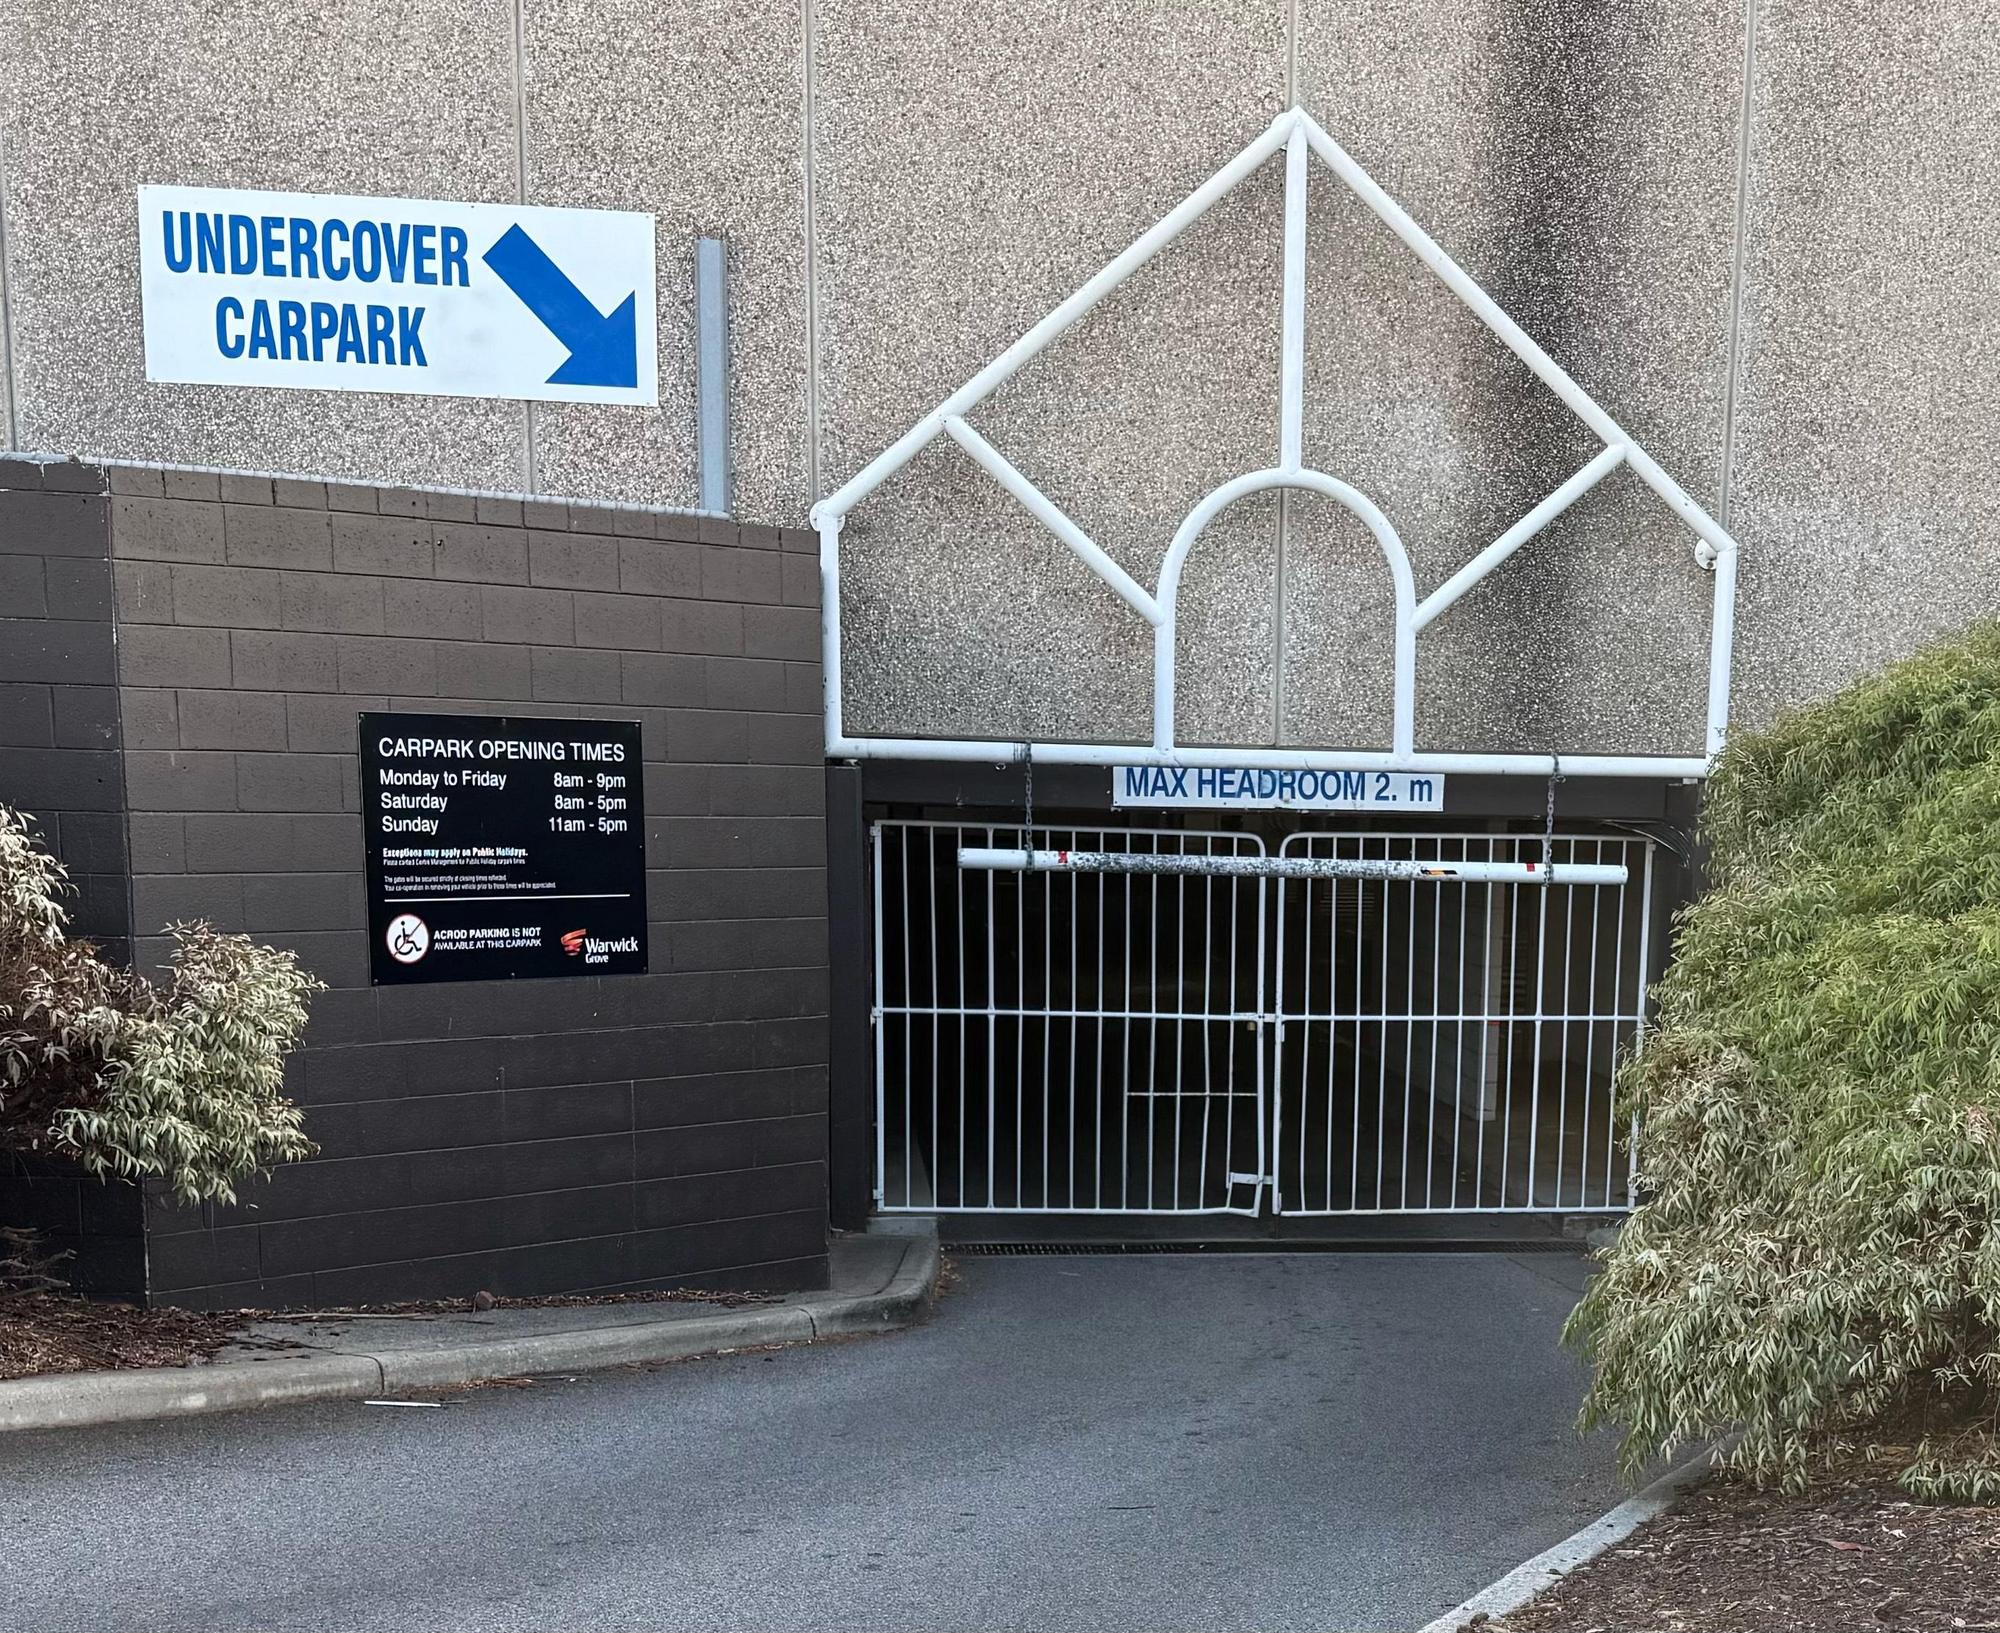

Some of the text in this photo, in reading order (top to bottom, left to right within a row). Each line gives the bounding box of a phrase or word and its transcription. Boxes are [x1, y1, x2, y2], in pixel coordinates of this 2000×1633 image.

[163, 210, 470, 287] UNDERCOVER
[216, 296, 428, 366] CARPARK
[379, 737, 625, 761] CARPARK OPENING TIMES
[379, 769, 440, 789] Monday
[443, 770, 458, 786] to
[462, 770, 507, 790] Friday
[553, 772, 584, 788] 8am
[596, 773, 626, 791] 9pm
[1126, 767, 1188, 798] MAX
[1197, 768, 1366, 801] HEADROOM
[1409, 782, 1433, 802] m
[380, 792, 448, 812] Saturday
[554, 794, 585, 810] 8am
[597, 795, 627, 813] 5pm
[381, 815, 439, 835] Sunday
[548, 816, 586, 832] 11am
[598, 817, 628, 835] 5pm
[382, 847, 528, 859] Exceptions may apply on Public Holidays.
[433, 926, 541, 940] ACROD PARKING IS NOT
[433, 938, 542, 951] AVAILABLE AT THIS CARPARK
[584, 936, 639, 953] Warwick
[585, 953, 609, 964] Grove
